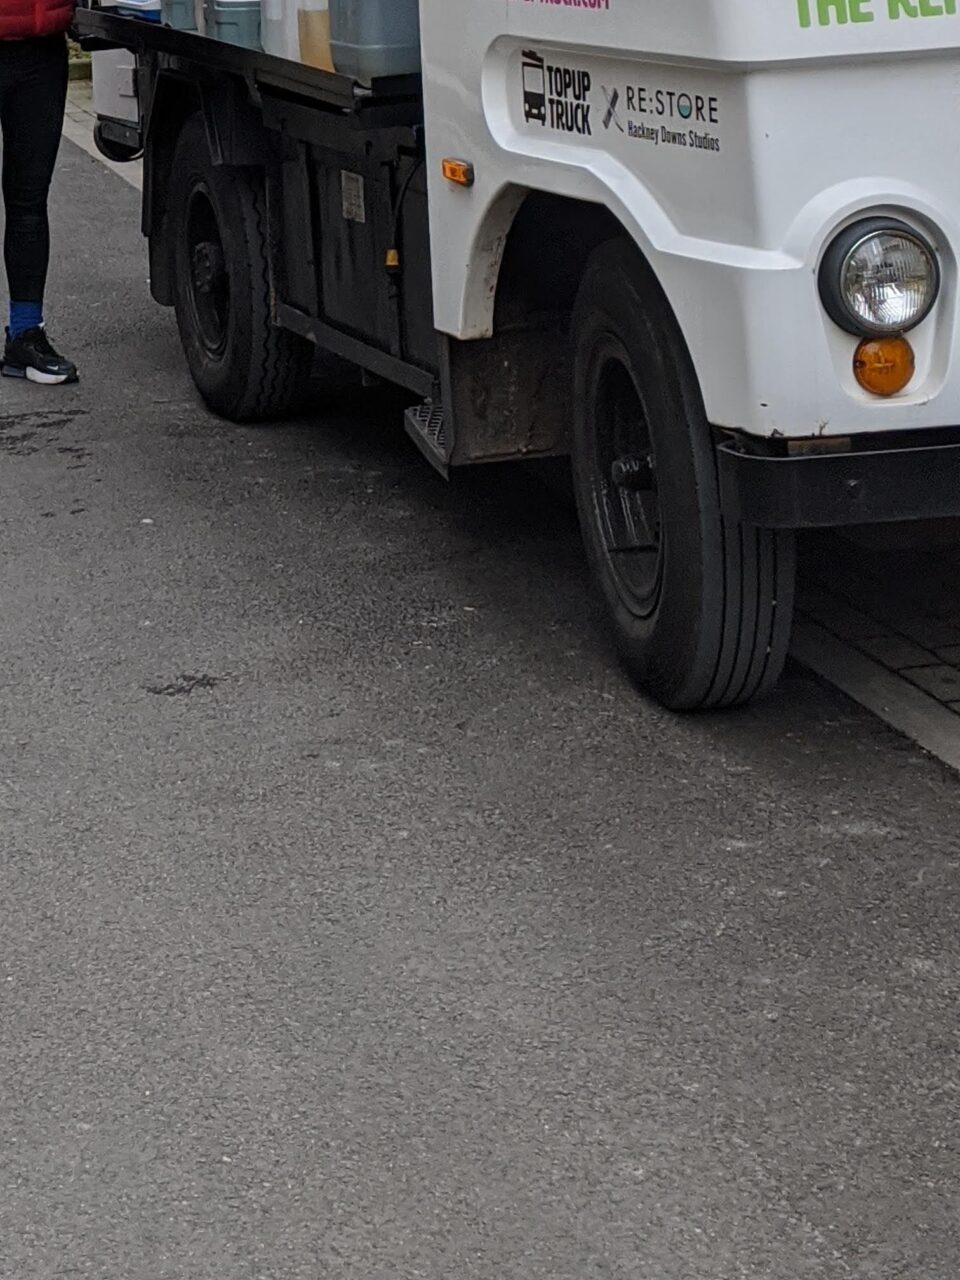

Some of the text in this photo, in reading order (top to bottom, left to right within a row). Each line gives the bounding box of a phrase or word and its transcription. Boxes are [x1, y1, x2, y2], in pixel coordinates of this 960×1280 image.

[546, 65, 591, 102] TOPUP
[548, 98, 592, 136] TRUCK
[626, 85, 719, 124] RE:STORE
[627, 120, 720, 152] Hackney Downs Studios
